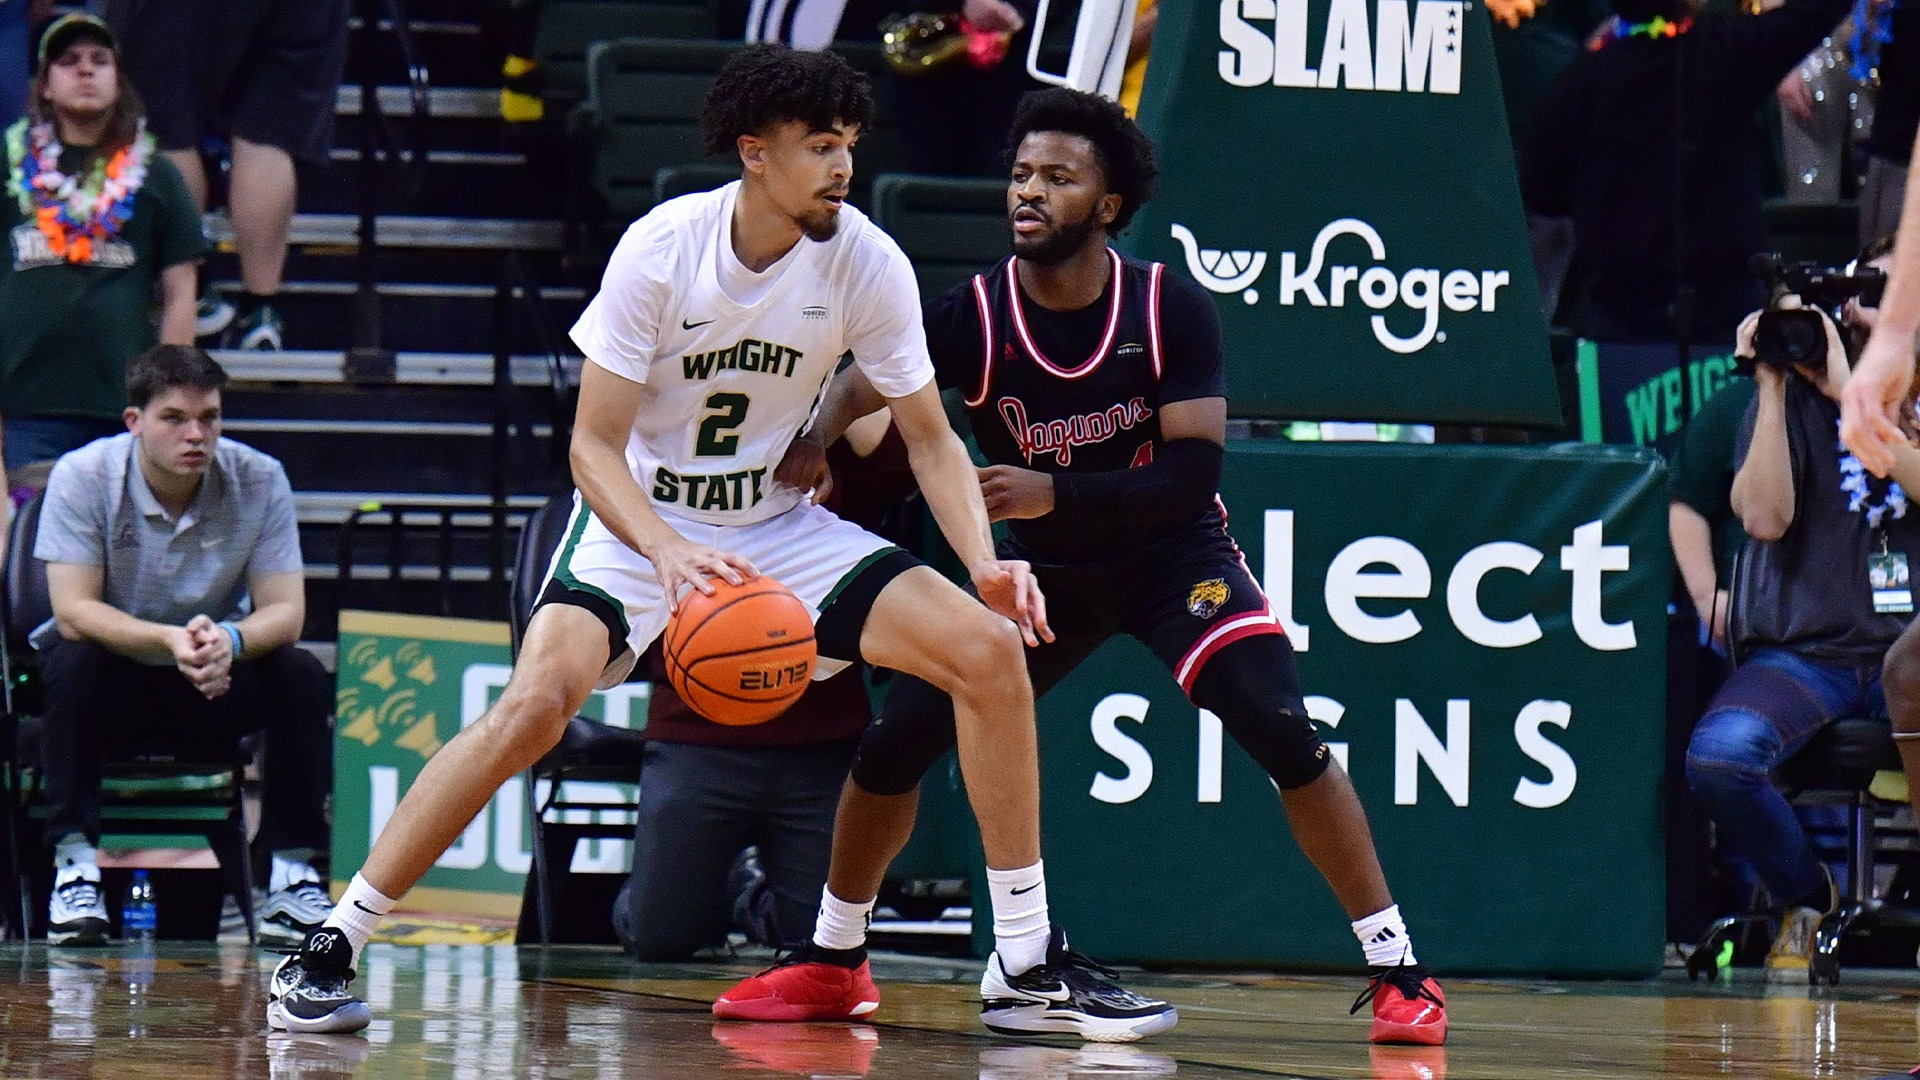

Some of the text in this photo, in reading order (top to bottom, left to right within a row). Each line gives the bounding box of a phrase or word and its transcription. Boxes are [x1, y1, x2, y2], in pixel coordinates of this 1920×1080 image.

[1218, 0, 1462, 94] SLAM
[1280, 217, 1509, 353] Kroger
[693, 390, 751, 458] 2
[998, 396, 1152, 467] Jaguars
[1264, 509, 1638, 652] lect
